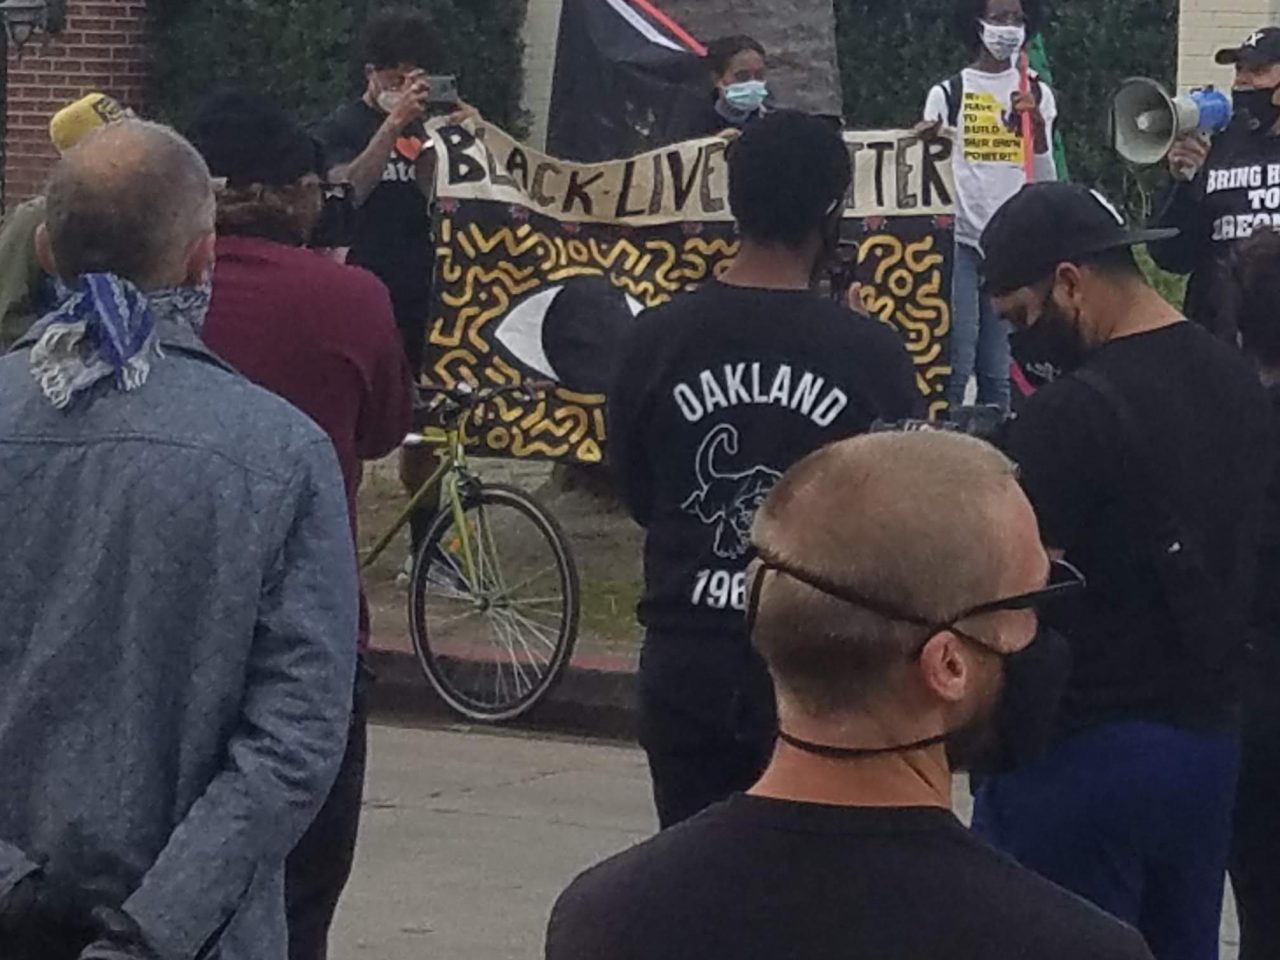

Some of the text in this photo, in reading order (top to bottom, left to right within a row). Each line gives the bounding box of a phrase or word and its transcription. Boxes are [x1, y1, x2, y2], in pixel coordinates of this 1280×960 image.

[963, 113, 978, 123] TO
[963, 125, 1001, 135] BUILD
[1206, 165, 1262, 194] BRING
[1247, 186, 1280, 209] TO
[672, 361, 848, 428] OAKLAND
